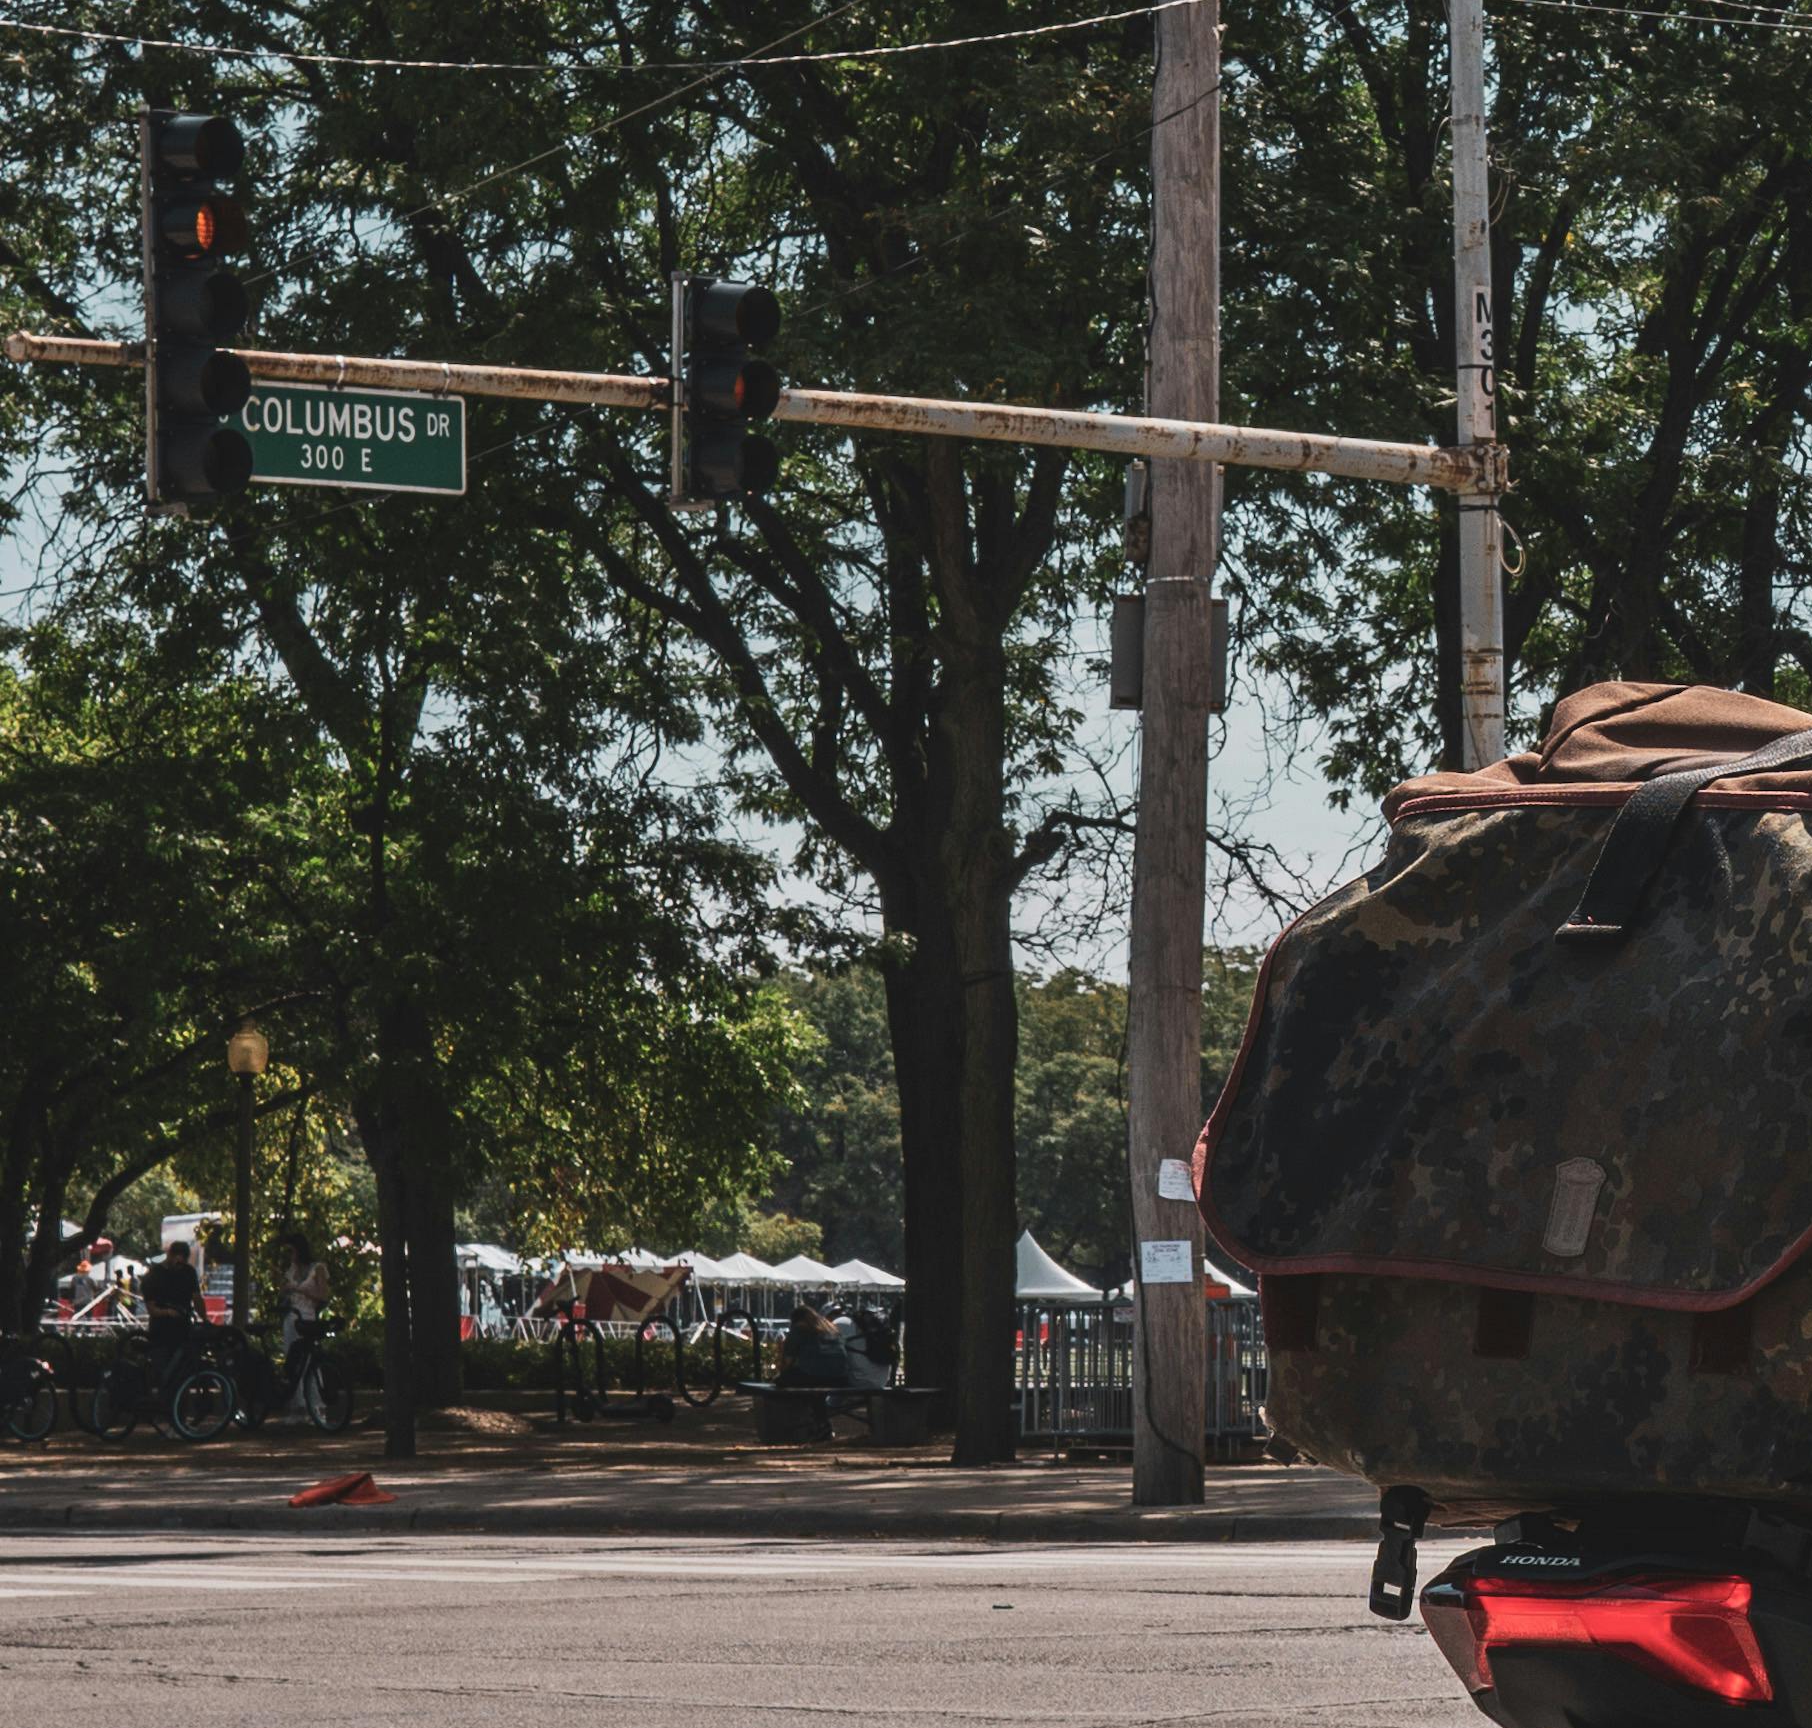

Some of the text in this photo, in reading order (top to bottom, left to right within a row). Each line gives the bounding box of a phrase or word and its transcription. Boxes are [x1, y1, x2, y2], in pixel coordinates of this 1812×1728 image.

[242, 395, 450, 442] COLUMBUS DR
[301, 444, 372, 472] 300 E
[1500, 1555, 1582, 1567] HONDA
